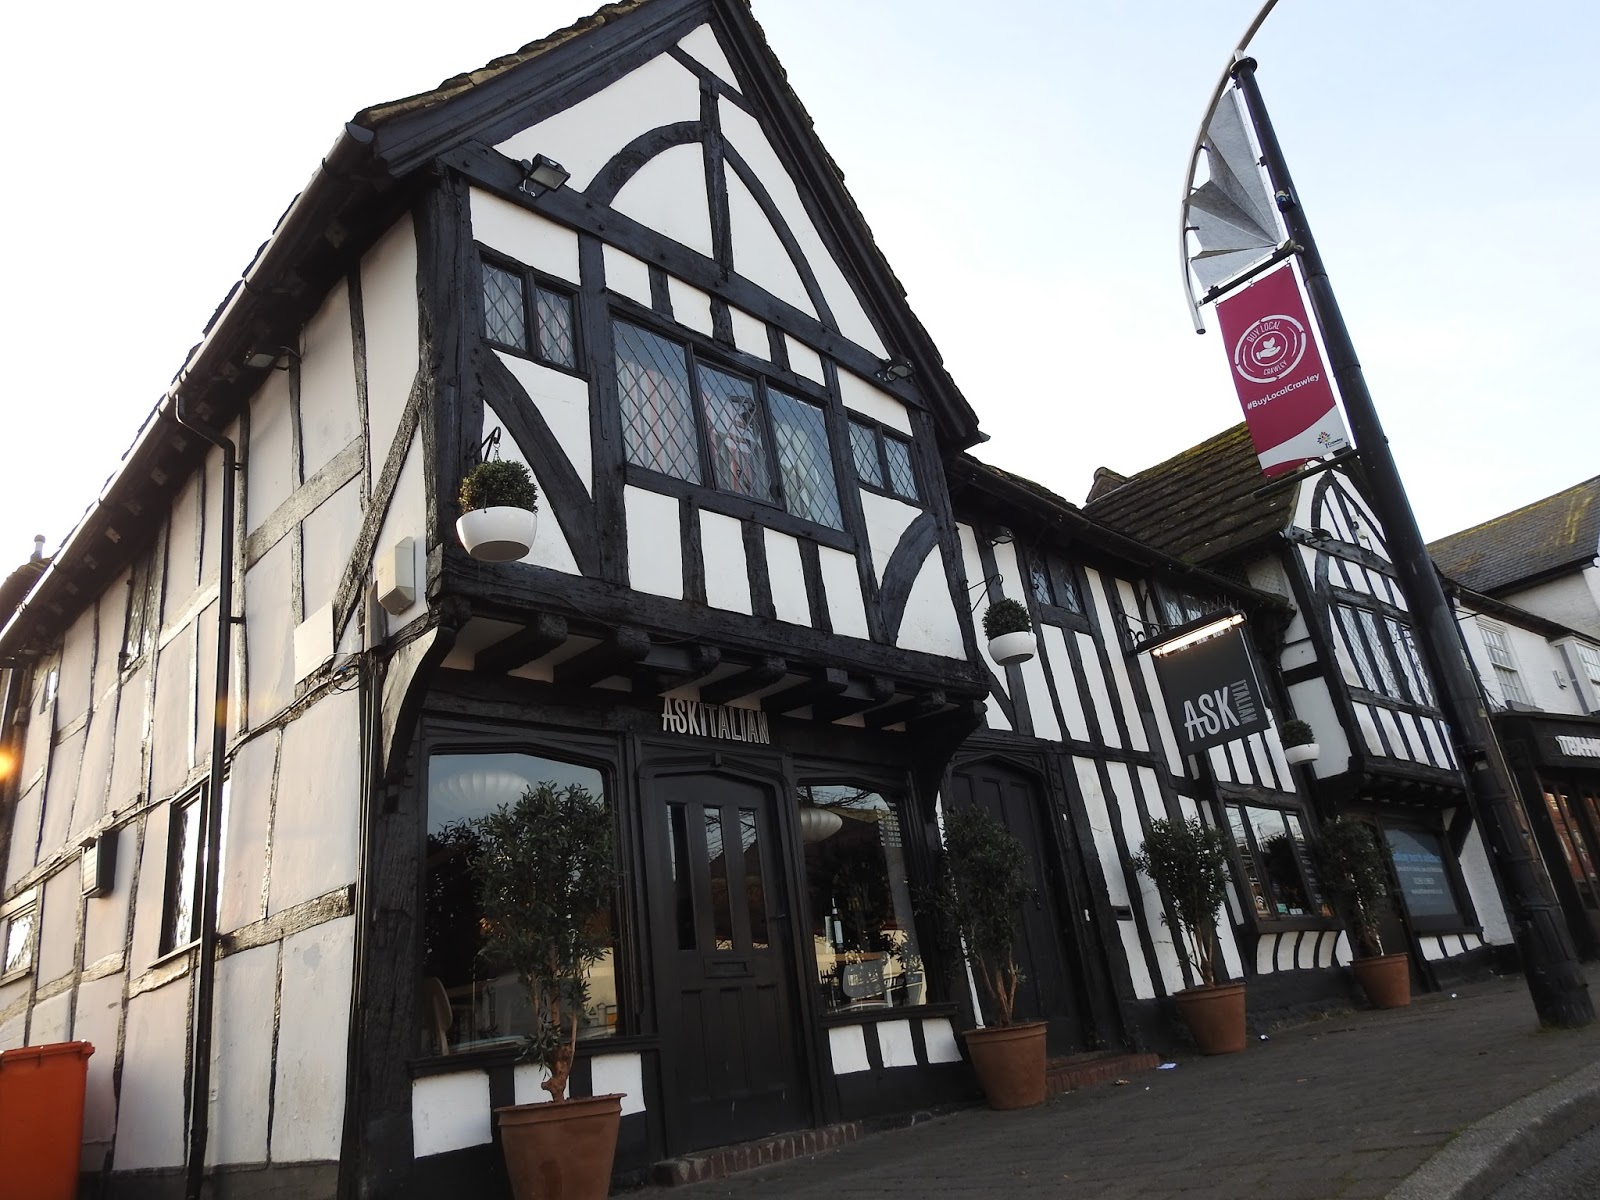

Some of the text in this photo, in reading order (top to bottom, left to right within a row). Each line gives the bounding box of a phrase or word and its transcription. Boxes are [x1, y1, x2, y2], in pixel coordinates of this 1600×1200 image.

[1246, 320, 1281, 343] BUY LOCAL
[1263, 360, 1288, 375] CRAWLEY
[1247, 373, 1320, 410] #BuyLocalCrawley
[1184, 679, 1258, 742] ASK ITALIAN
